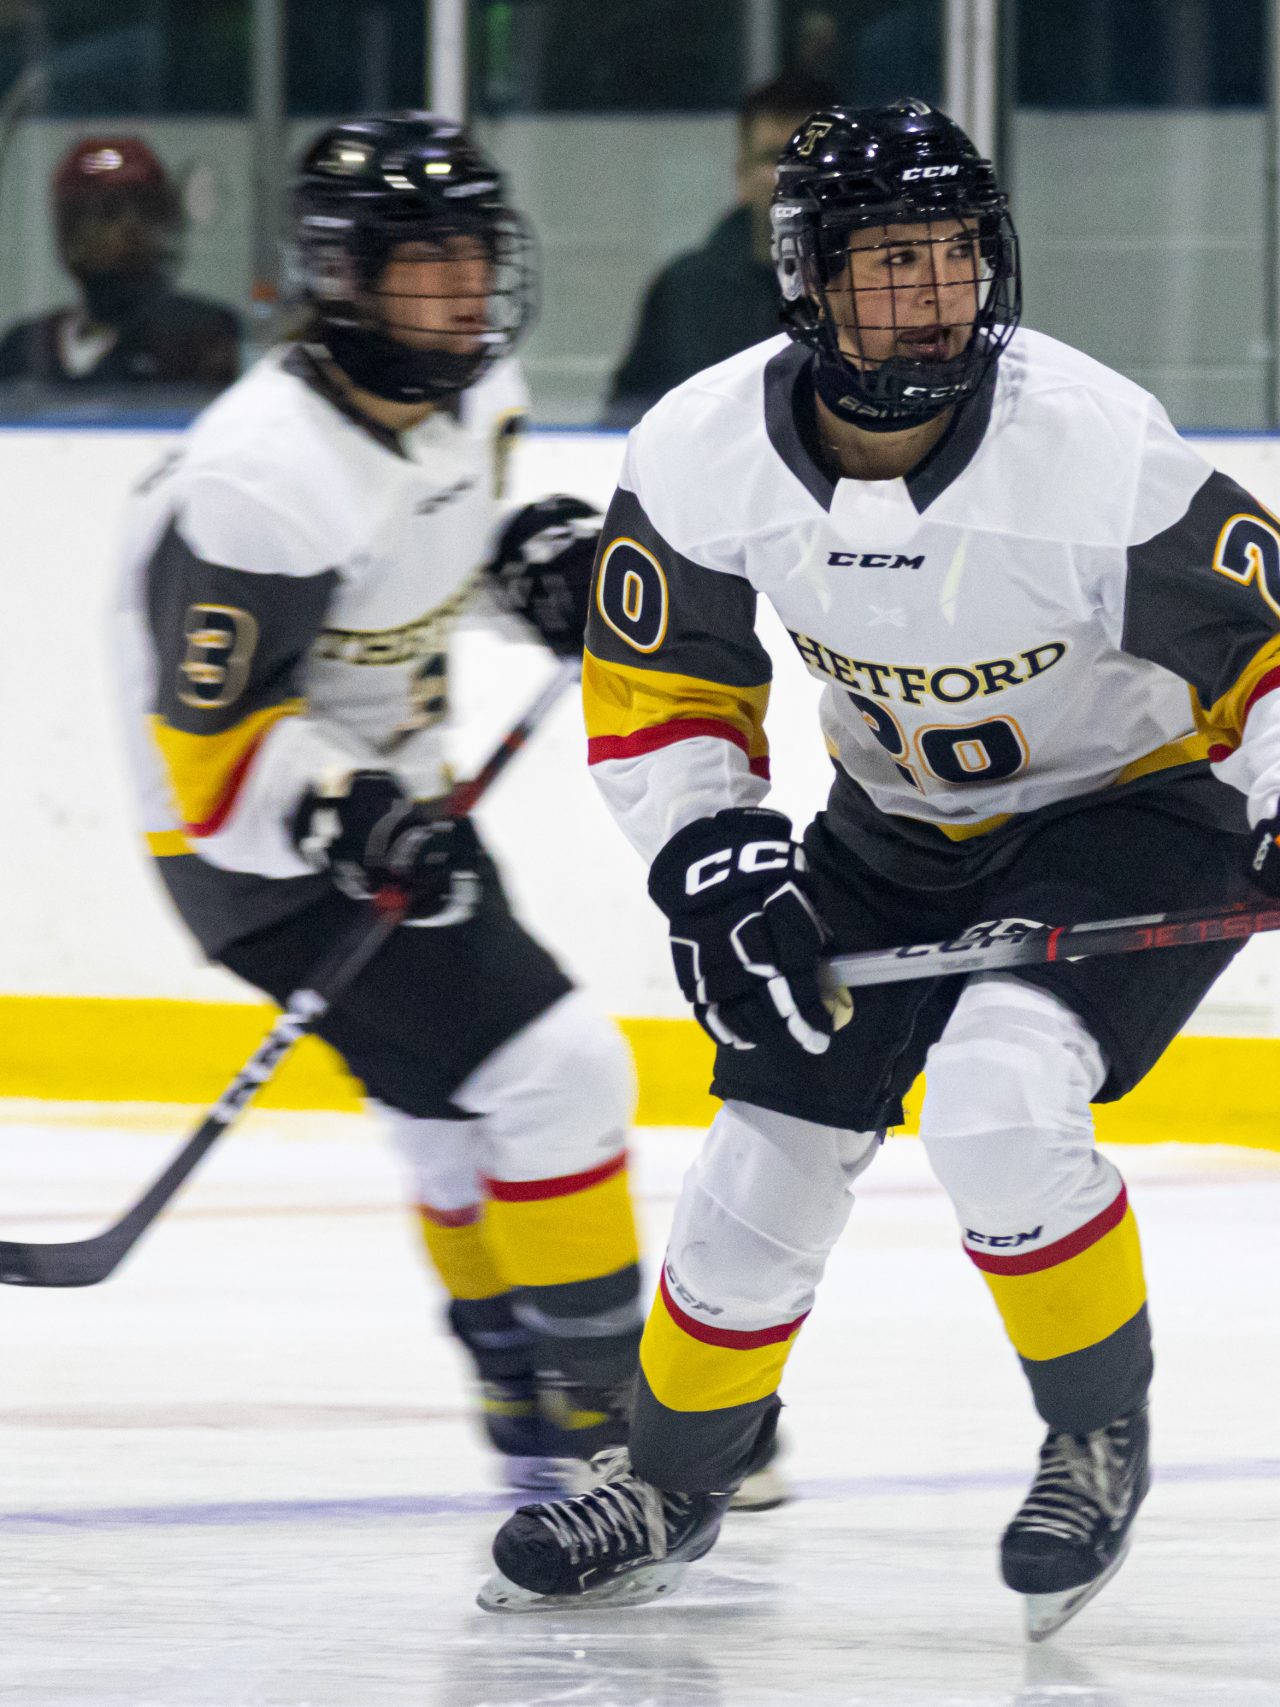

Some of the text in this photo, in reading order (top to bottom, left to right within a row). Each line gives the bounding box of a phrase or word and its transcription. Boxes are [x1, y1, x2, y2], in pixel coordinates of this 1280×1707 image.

[902, 165, 959, 181] CCM
[827, 552, 925, 569] CCM
[966, 1225, 1043, 1247] CCM
[666, 1264, 723, 1315] CCM
